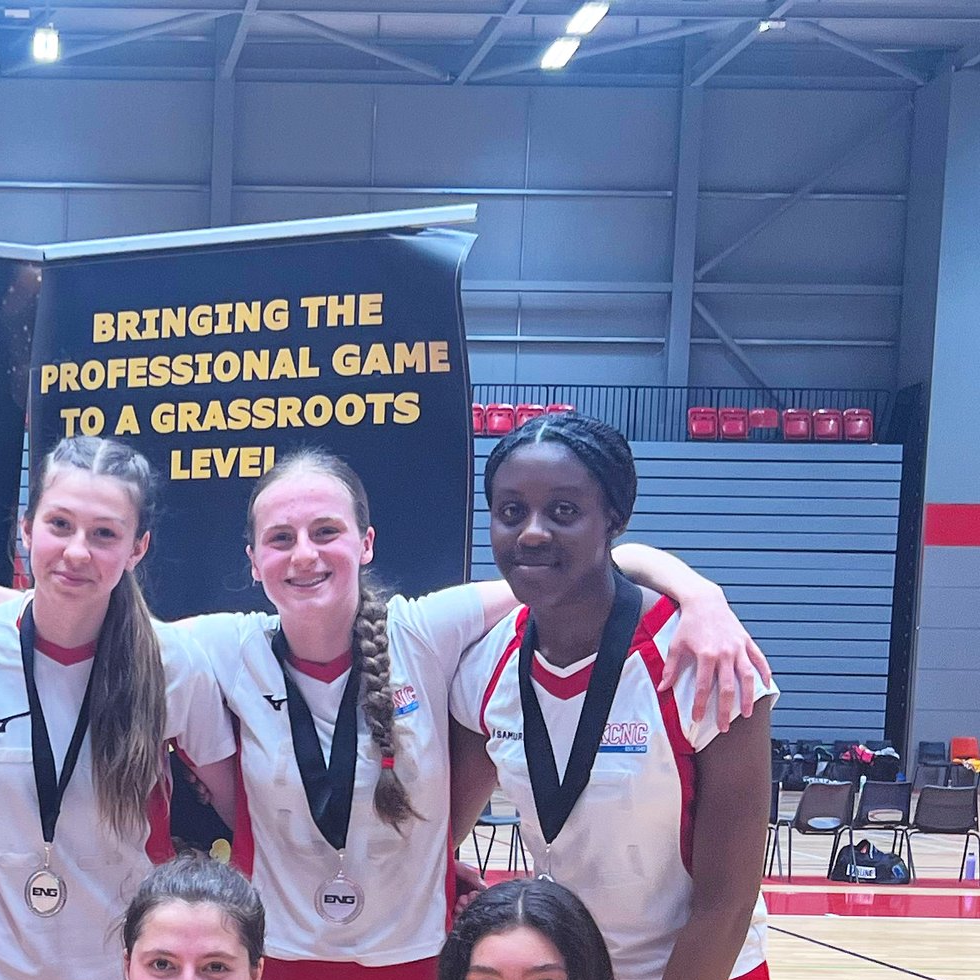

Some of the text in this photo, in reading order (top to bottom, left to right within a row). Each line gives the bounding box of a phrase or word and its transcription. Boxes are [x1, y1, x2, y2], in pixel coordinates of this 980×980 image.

[92, 293, 384, 343] BRINGING THE
[40, 341, 451, 394] PROFESSIONAL GAME
[60, 392, 421, 438] TO A GRASSROOTS
[32, 887, 58, 898] ENG
[324, 894, 355, 905] ENG
